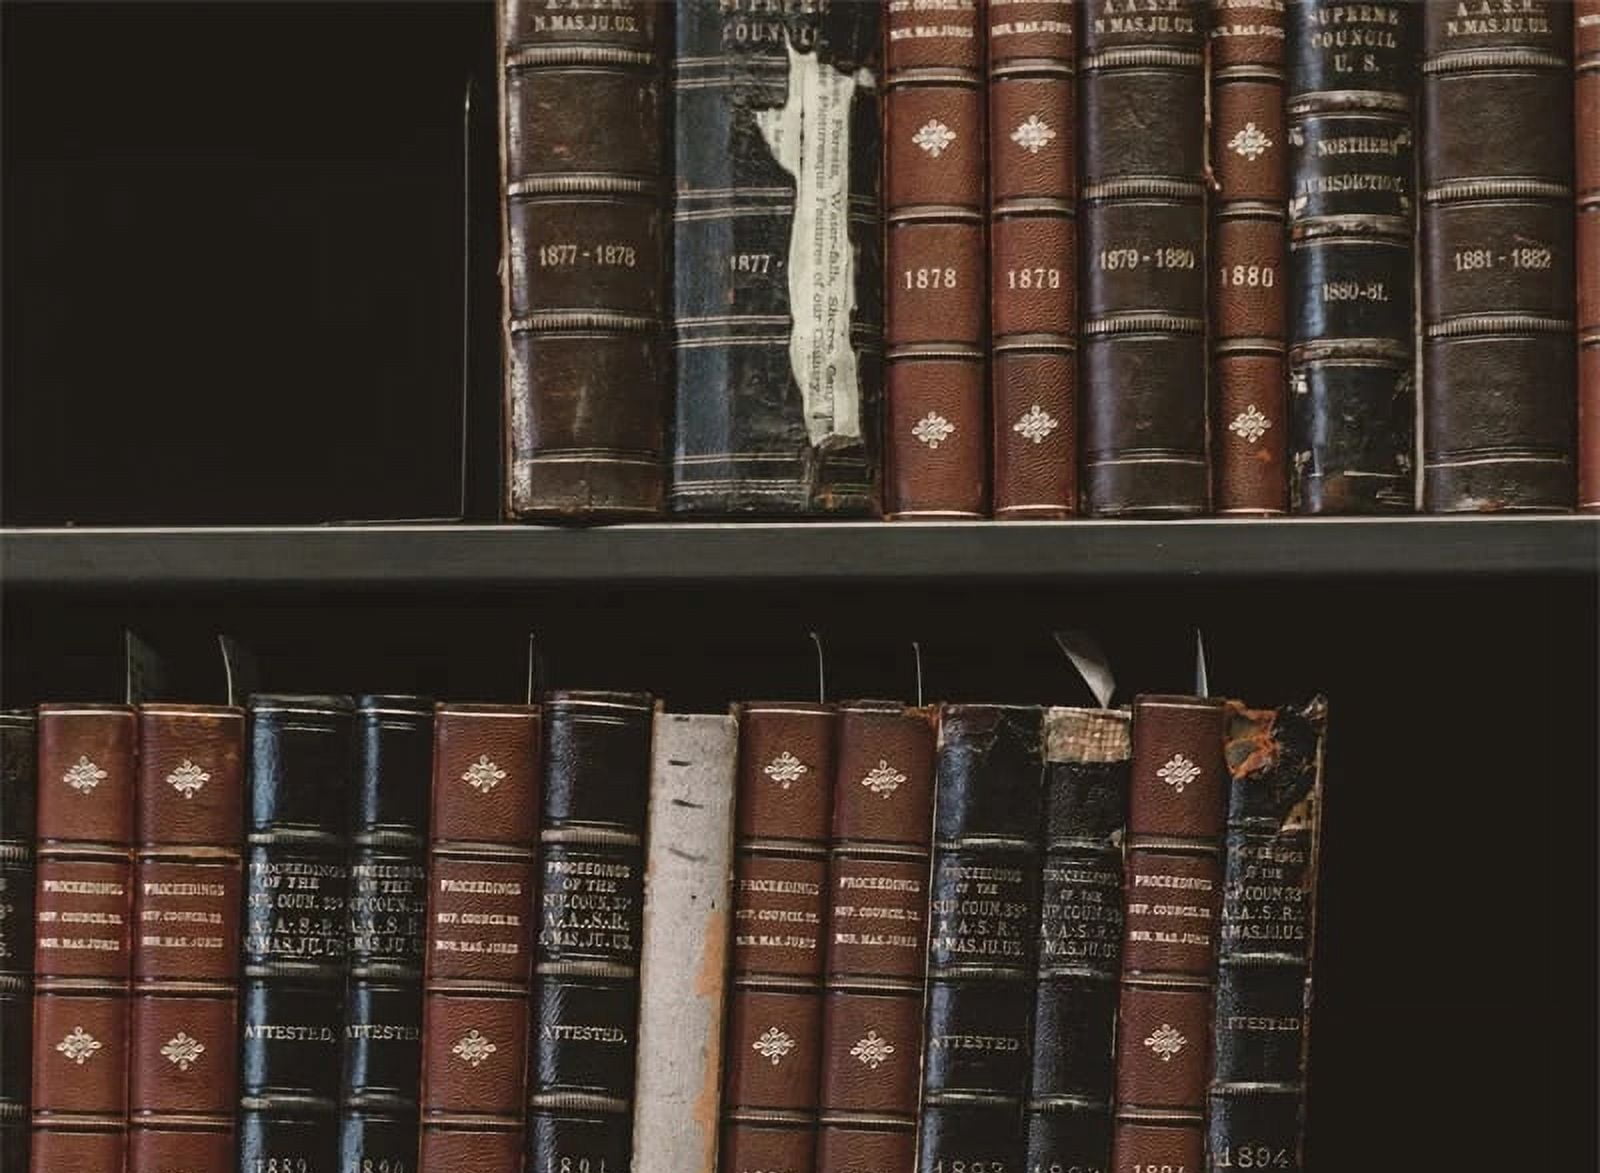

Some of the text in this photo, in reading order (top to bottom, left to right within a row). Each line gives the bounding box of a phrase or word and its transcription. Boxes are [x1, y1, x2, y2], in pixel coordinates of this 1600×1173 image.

[1311, 29, 1396, 48] COUNCIL
[540, 245, 576, 267] 1877
[596, 245, 636, 267] 1878
[1100, 249, 1136, 270] 1879
[1156, 248, 1194, 269] 1880
[1455, 250, 1493, 272] 1881
[1511, 248, 1551, 270] 1882
[904, 268, 957, 289] 1878
[1007, 268, 1060, 289] 1879
[1220, 265, 1274, 288] 1880
[547, 861, 631, 878] PROCEEDINGS
[563, 879, 618, 893] OF THE
